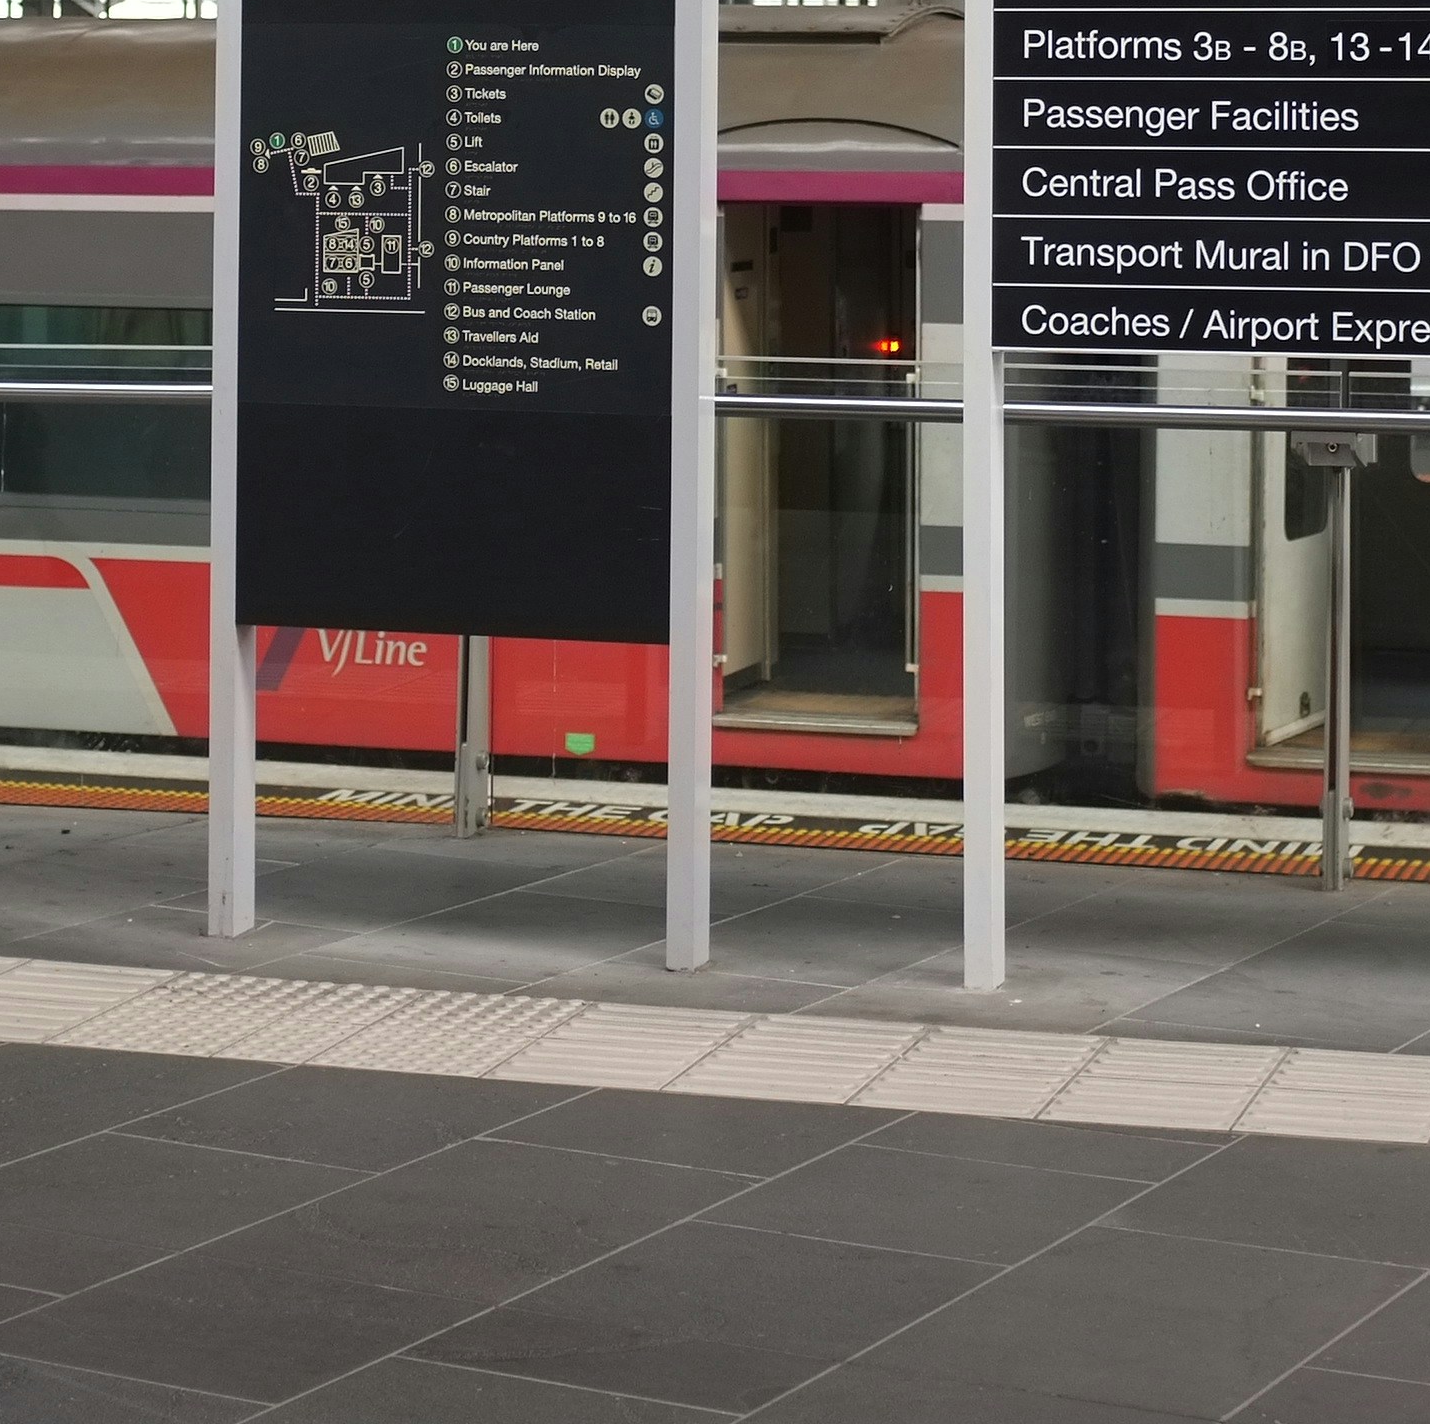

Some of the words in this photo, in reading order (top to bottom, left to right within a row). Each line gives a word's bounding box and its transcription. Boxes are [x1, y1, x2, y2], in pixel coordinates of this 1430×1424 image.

[465, 39, 487, 51] You
[490, 42, 508, 51] are
[512, 39, 539, 51] Here
[1024, 29, 1181, 60] Platforms
[1194, 32, 1231, 61] 3B
[1269, 32, 1315, 67] 8B,
[1331, 32, 1369, 62] 13
[466, 64, 526, 78] Passenger
[530, 64, 594, 77] Information
[599, 64, 641, 79] Display
[465, 87, 506, 100] Tickets
[465, 111, 501, 124] Toilets
[1024, 98, 1199, 136] Passenger
[1212, 101, 1358, 131] Facilities
[465, 136, 482, 148] Lift
[465, 159, 518, 172] Escalator
[464, 184, 491, 196] Stair
[1023, 166, 1140, 197] Central
[1156, 168, 1235, 200] Pass
[1247, 170, 1348, 201] Office
[464, 209, 535, 223] Metropolitan
[540, 210, 595, 223] Platforms
[598, 211, 605, 222] 9
[609, 212, 620, 224] to
[624, 212, 636, 224] 16
[464, 233, 509, 248] Country
[513, 234, 567, 246] Platforms
[572, 235, 576, 246] 1
[582, 235, 593, 247] to
[597, 235, 604, 247] 8
[1021, 236, 1182, 274] Transport
[1196, 240, 1288, 271] Mural
[1303, 241, 1329, 271] in
[1345, 241, 1420, 273] DFO
[464, 258, 528, 270] Information
[532, 258, 564, 270] Panel
[463, 281, 524, 297] Passenger
[527, 283, 570, 298] Lounge
[463, 305, 485, 318] Bus
[489, 307, 510, 318] and
[514, 307, 551, 319] Coach
[555, 307, 595, 321] Station
[1021, 305, 1170, 337] Coaches
[1203, 310, 1319, 347] Airport
[462, 329, 516, 343] Travellers
[519, 331, 538, 343] Aid
[463, 354, 526, 369] Docklands,
[530, 357, 581, 371] Stadium,
[586, 358, 618, 371] Retail
[463, 379, 513, 394] Luggage
[516, 380, 538, 392] Hall
[317, 789, 455, 809] MIN
[510, 798, 642, 820] THE
[1019, 829, 1155, 849] THE
